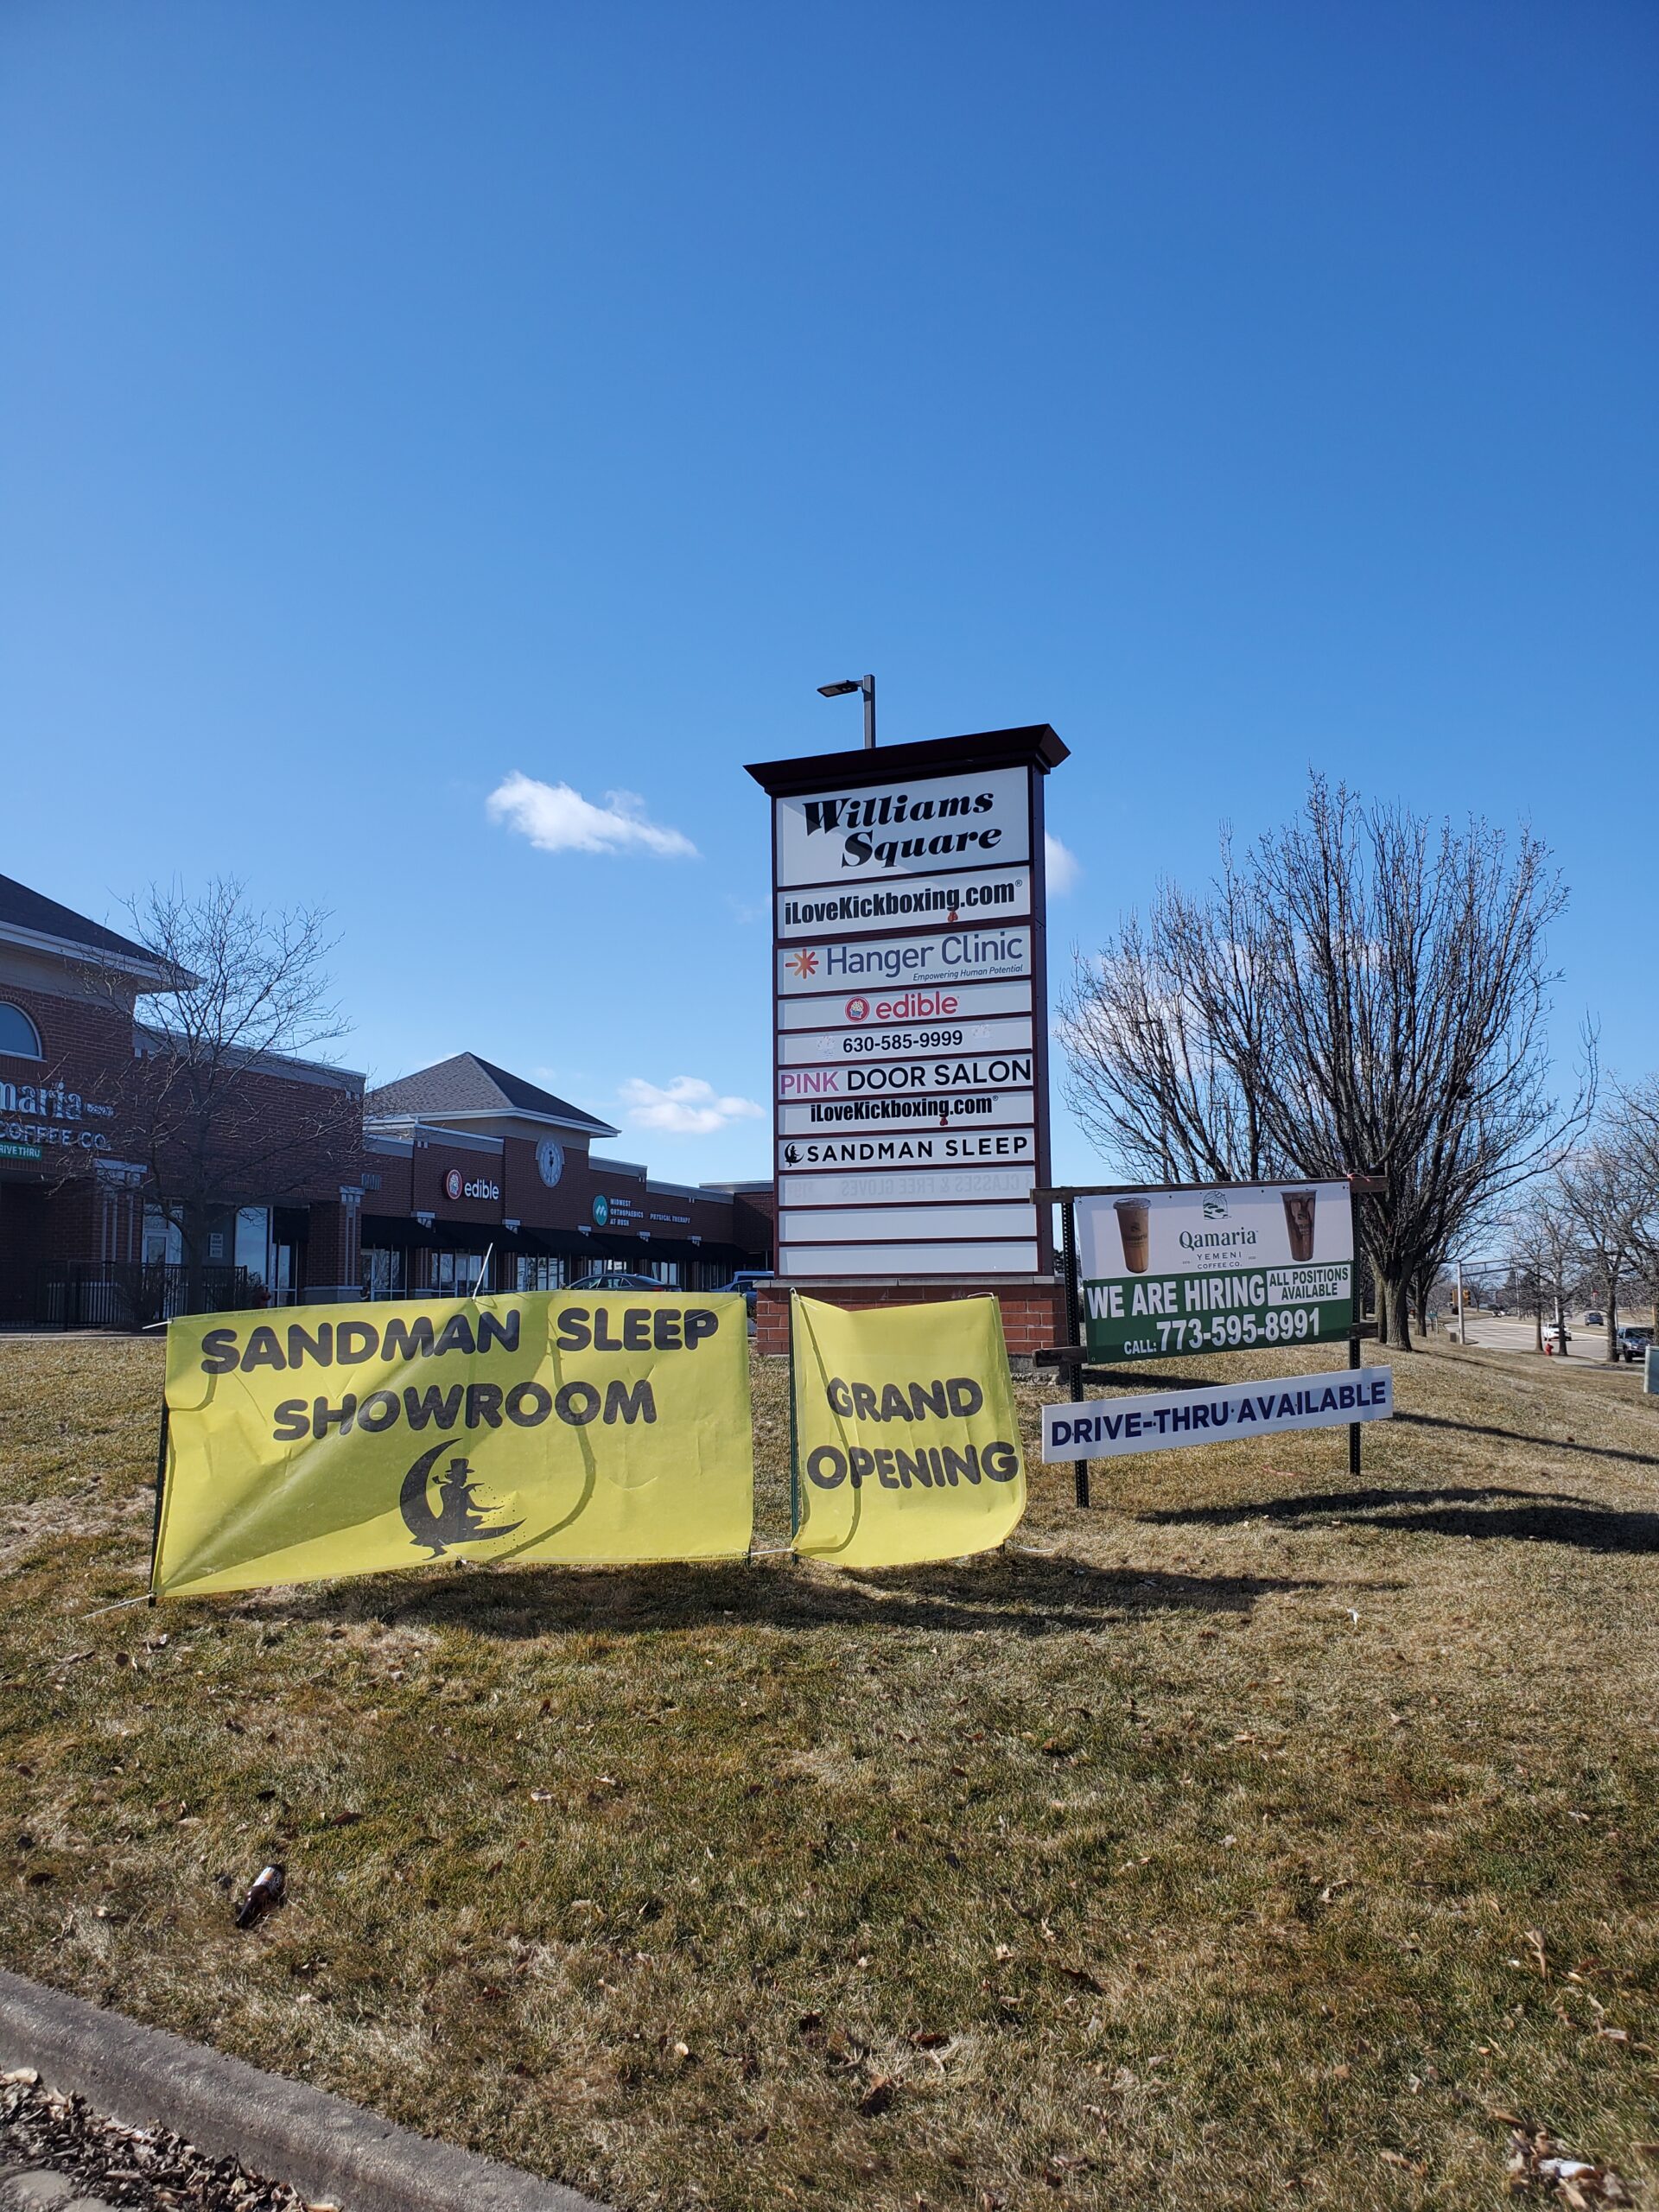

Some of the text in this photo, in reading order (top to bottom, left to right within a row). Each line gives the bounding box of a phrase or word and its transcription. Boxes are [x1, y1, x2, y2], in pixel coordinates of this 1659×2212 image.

[802, 791, 994, 836] Williams
[842, 829, 1002, 868] Square
[827, 931, 1023, 978] Hanger Clinic
[912, 964, 1023, 982] Empowering Human Potential
[875, 991, 958, 1020] edible
[842, 1030, 963, 1053] 630-585-9999
[780, 1059, 1032, 1095] PINK DOOR SALON
[18, 1147, 40, 1158] THRU
[807, 1136, 1028, 1163] SANDMAN SLEEP
[464, 1178, 499, 1200] edible
[1179, 1227, 1257, 1251] Qamaria
[1197, 1251, 1242, 1261] YEMENI
[1269, 1268, 1349, 1287] ALL POSITIONS
[1281, 1282, 1338, 1301] AVAILABLE
[1086, 1274, 1266, 1319] WE ARE HIRING
[200, 1306, 719, 1375] SANDMAN SLEEP
[1123, 1306, 1319, 1355] CALL: 773-595-8991
[272, 1379, 657, 1442] SHOWROOM
[827, 1376, 984, 1424] GRAND
[1052, 1381, 1386, 1446] DRIVE-THRU AVAILABLE
[807, 1440, 1017, 1490] OPENING
